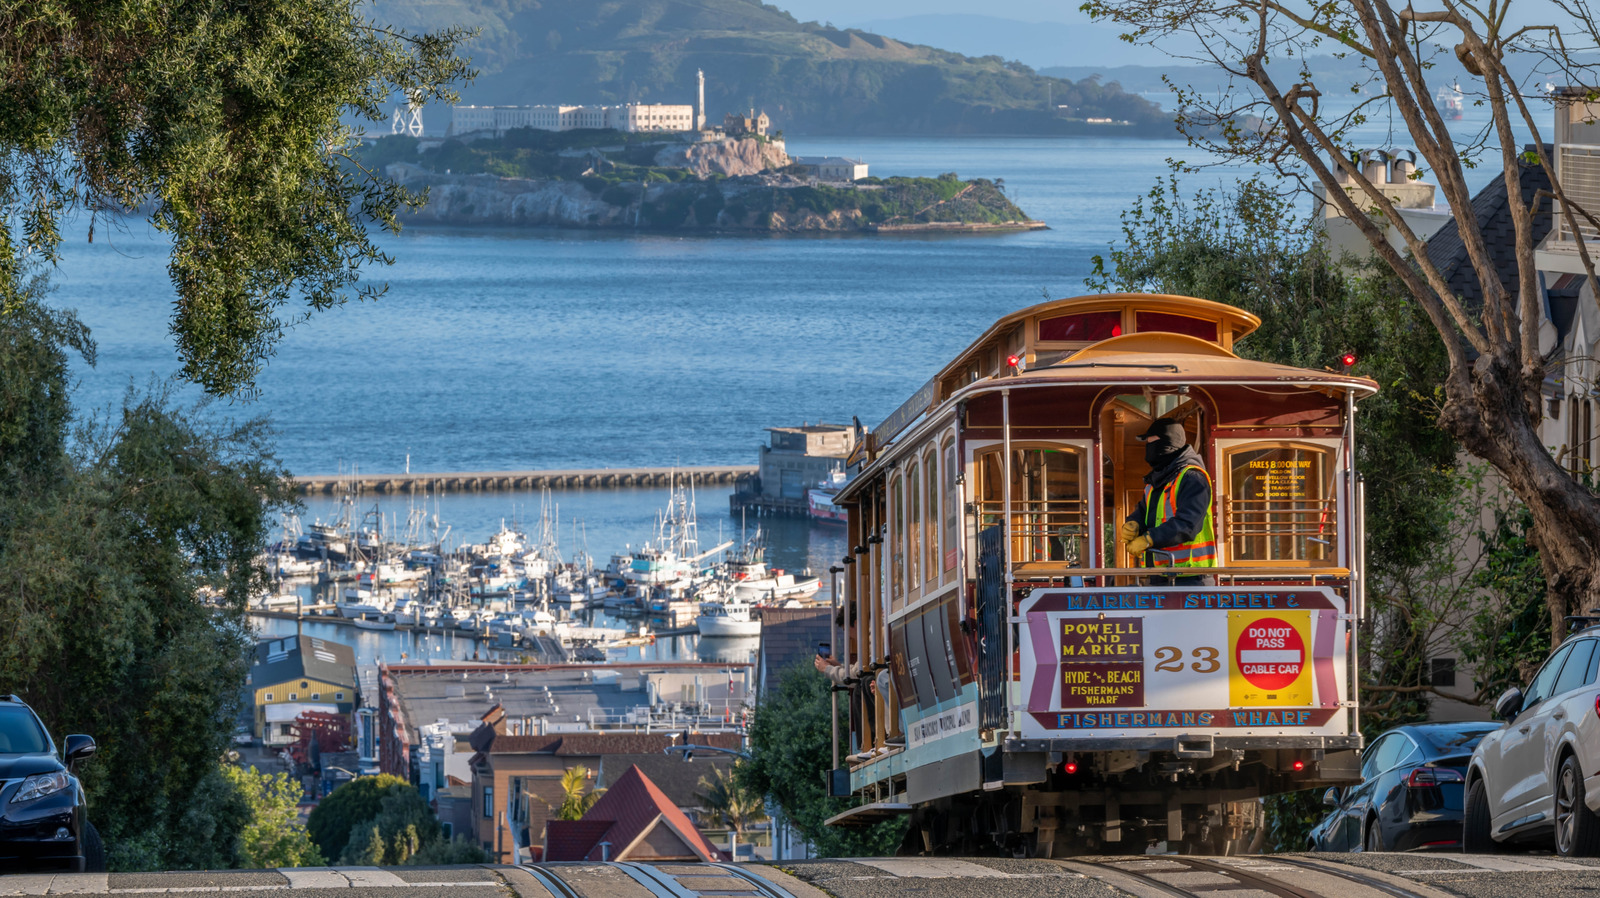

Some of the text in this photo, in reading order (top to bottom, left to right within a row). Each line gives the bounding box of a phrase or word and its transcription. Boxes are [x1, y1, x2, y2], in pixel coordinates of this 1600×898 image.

[1067, 594, 1166, 610] MARKET
[1184, 593, 1278, 609] STREET
[1064, 623, 1139, 635] POWELL
[1249, 628, 1292, 638] DO NOT
[1083, 634, 1121, 644] AND
[1256, 638, 1285, 648] PASS
[1062, 644, 1140, 656] MARKET
[1154, 646, 1221, 674] 23
[1243, 664, 1299, 674] CABLE CAR
[1064, 671, 1091, 684] HYDE
[1107, 671, 1141, 684] BEACH
[1070, 686, 1134, 695] FISHERMANS
[1085, 696, 1119, 704] WHARF
[1057, 710, 1311, 728] FISHERMANS WHARF
